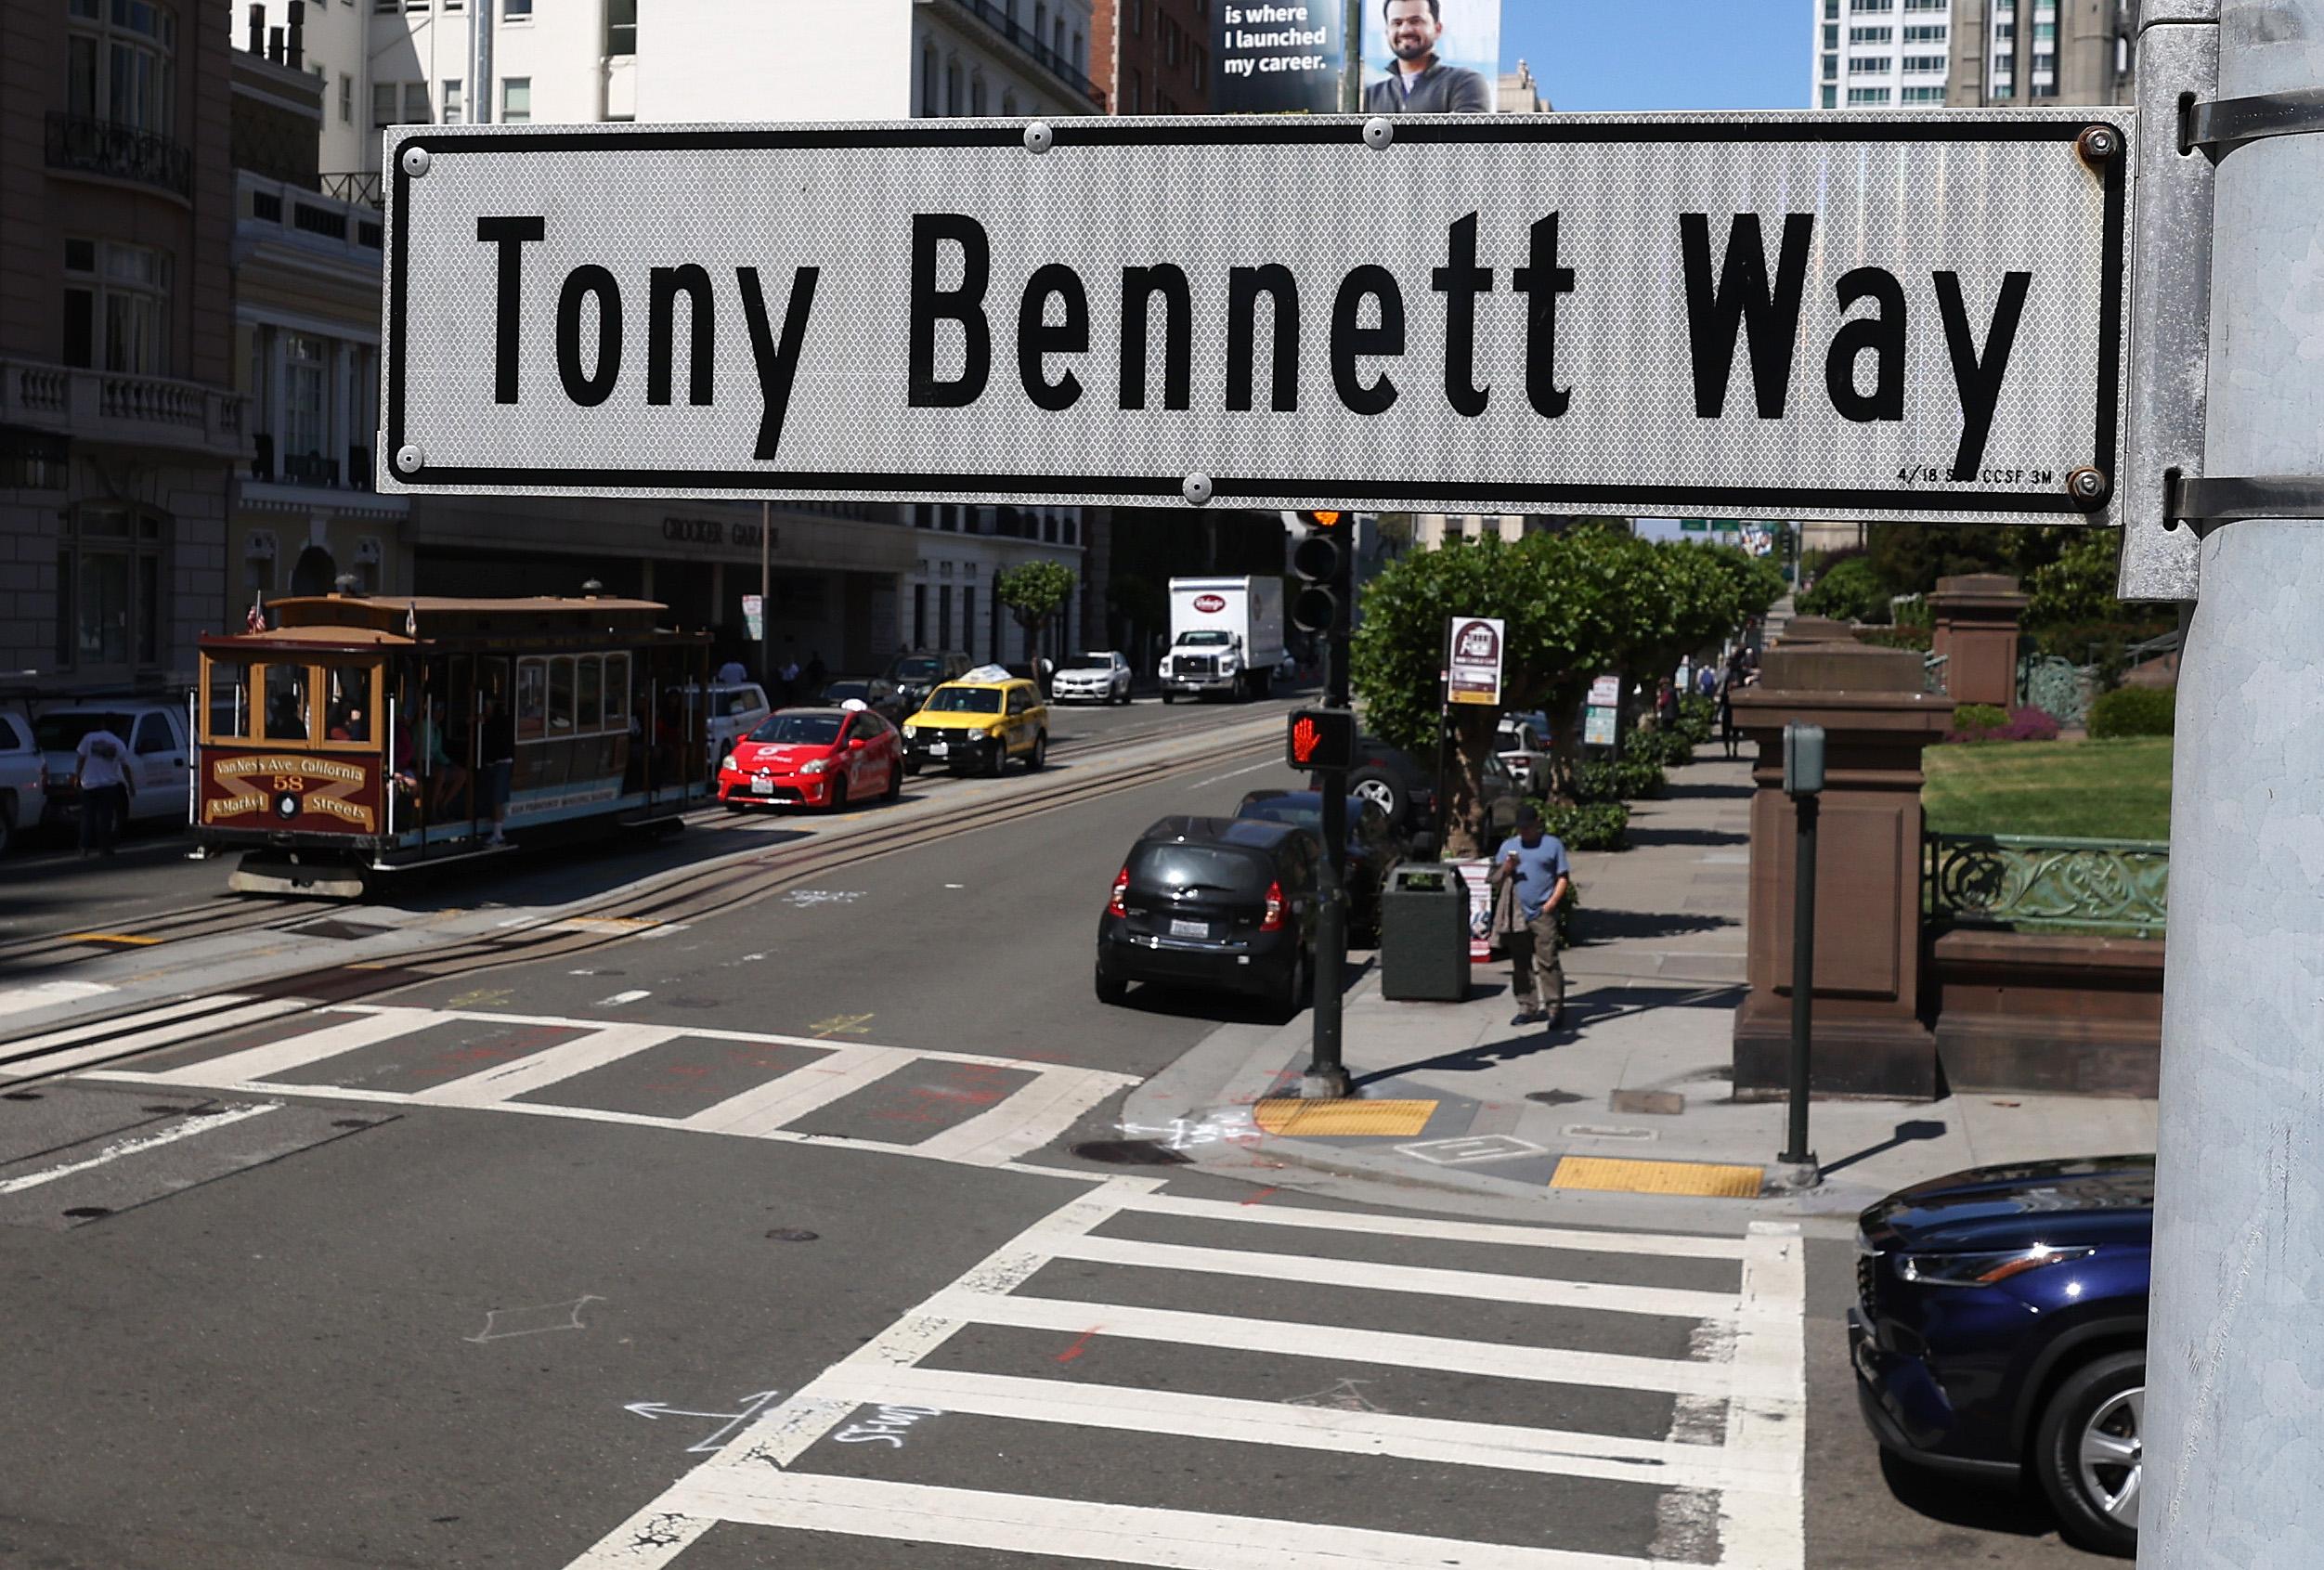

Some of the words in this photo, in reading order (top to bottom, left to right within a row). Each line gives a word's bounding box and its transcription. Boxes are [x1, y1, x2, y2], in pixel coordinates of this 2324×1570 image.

[1225, 5, 1242, 24] is
[1245, 4, 1308, 23] where
[1225, 31, 1232, 49] I
[1236, 26, 1327, 49] launched
[1224, 58, 1255, 78] my
[1258, 55, 1327, 72] career.
[477, 216, 820, 461] Tony
[908, 212, 1575, 420] Bennett
[1679, 213, 2032, 481] Way
[1897, 464, 1937, 485] 4/18
[1982, 469, 2025, 485] CCSF
[2031, 470, 2052, 485] 3M
[301, 759, 364, 782] California
[273, 774, 305, 791] 58
[312, 797, 365, 819] Streets
